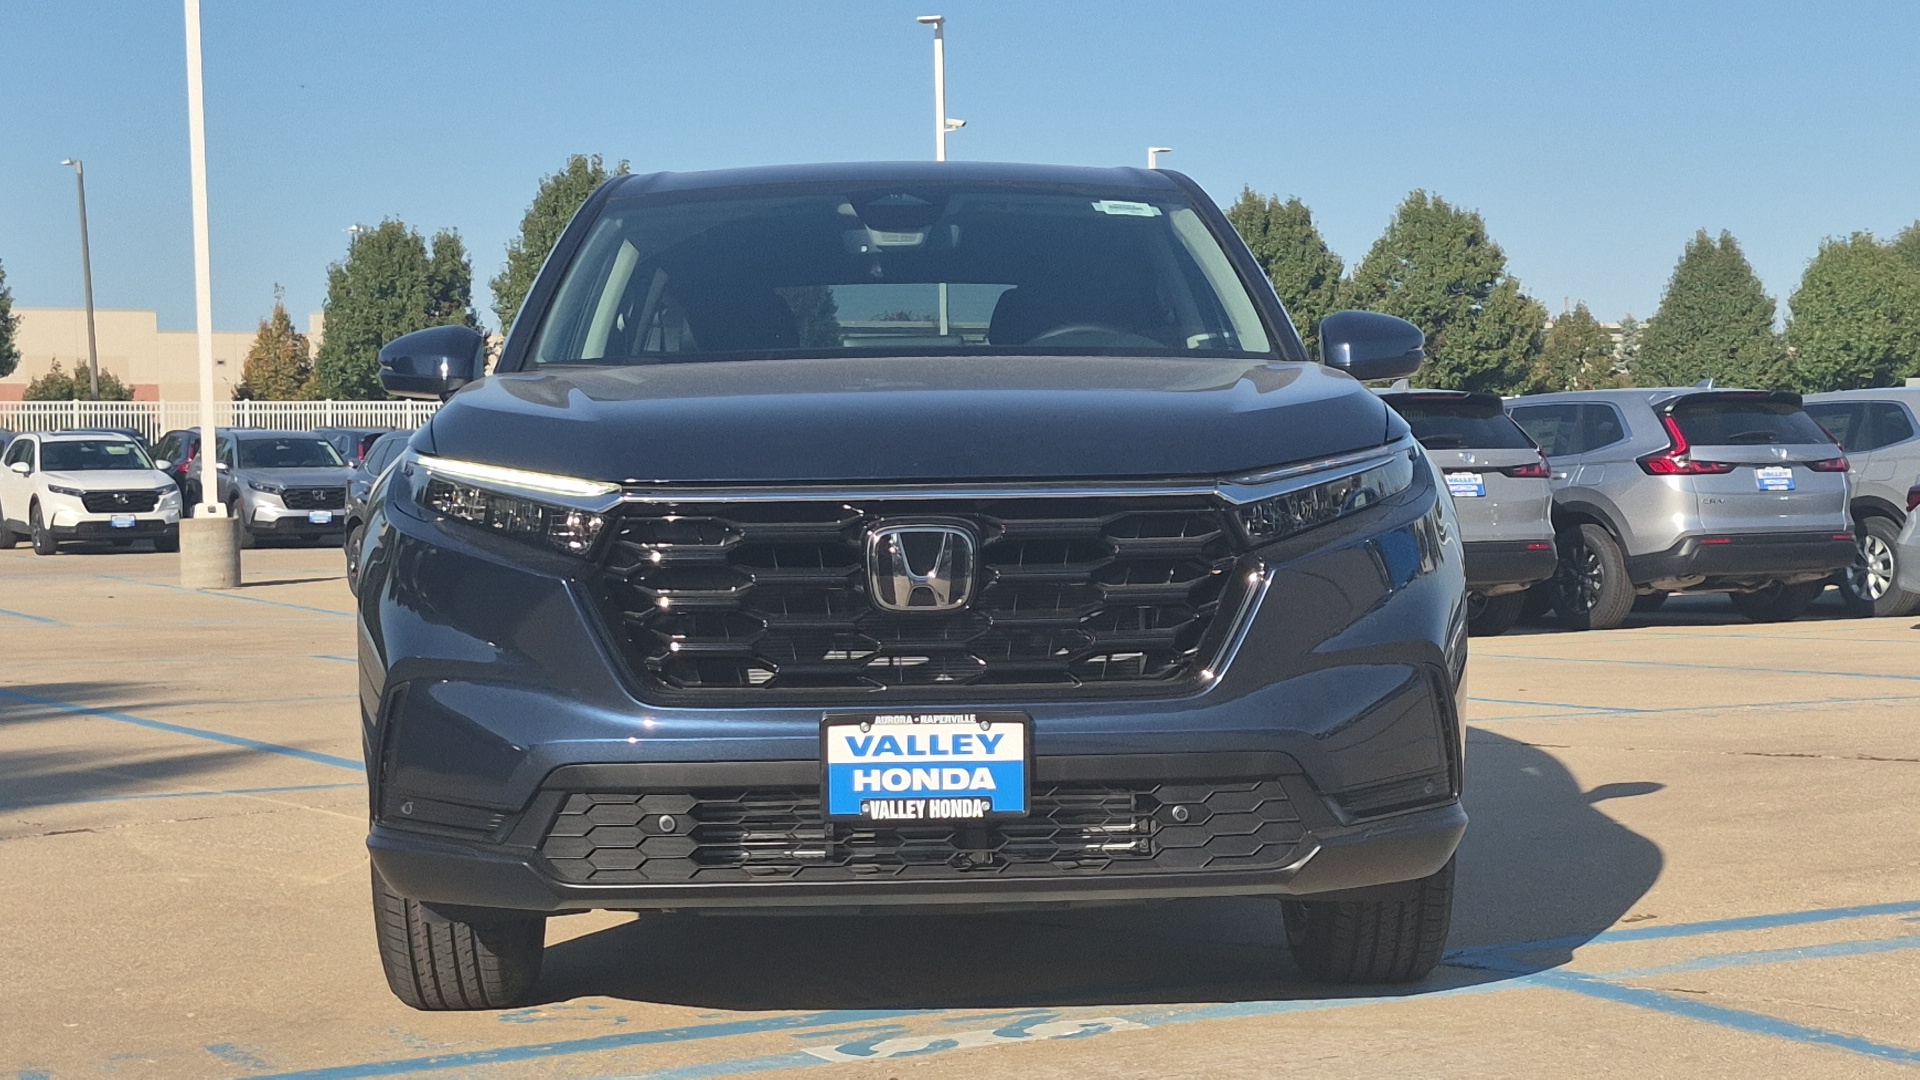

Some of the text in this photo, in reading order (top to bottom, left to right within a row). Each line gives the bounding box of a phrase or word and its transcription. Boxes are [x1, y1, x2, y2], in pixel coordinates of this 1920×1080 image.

[874, 714, 977, 724] AURORA NAPERVILLE
[844, 733, 1005, 757] VALLEY
[853, 767, 997, 792] HONDA
[869, 798, 985, 820] VALLEY HONDA
